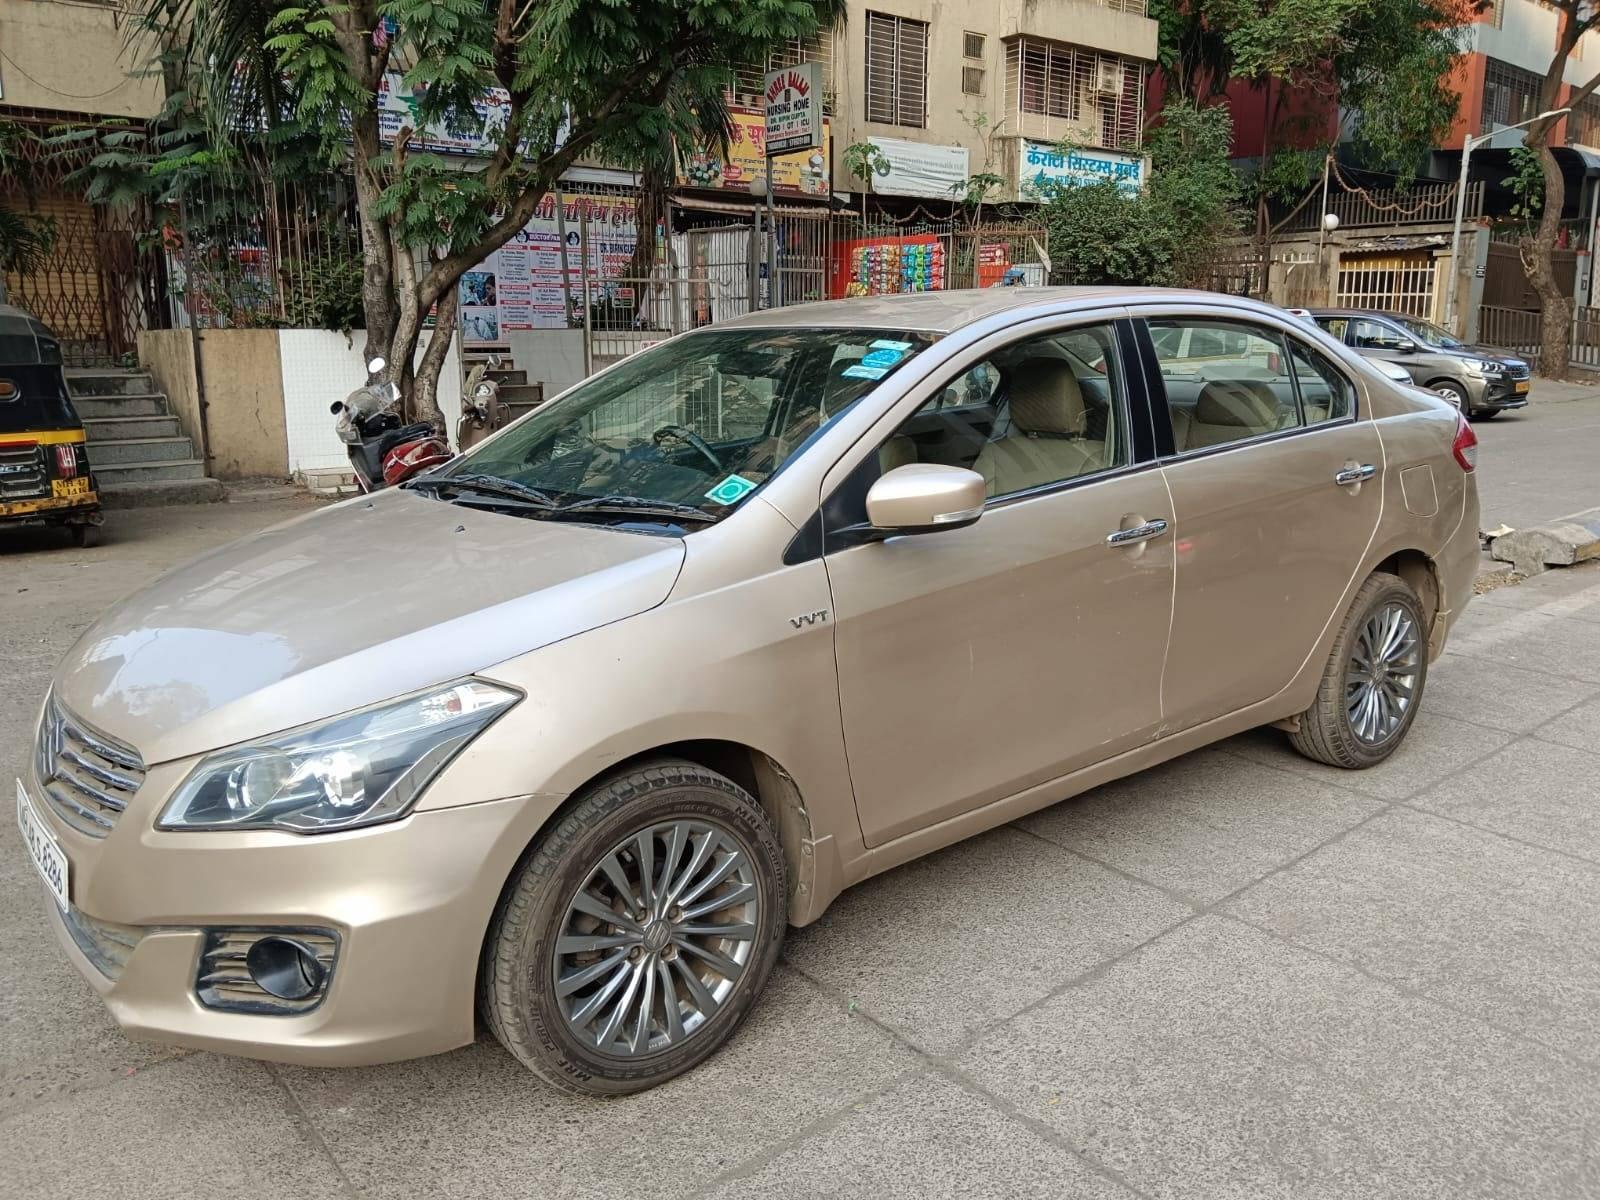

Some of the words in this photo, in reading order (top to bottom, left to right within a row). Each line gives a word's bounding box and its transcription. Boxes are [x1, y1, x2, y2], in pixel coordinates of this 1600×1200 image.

[767, 102, 791, 117] NURSING
[794, 98, 809, 111] HOME
[790, 610, 827, 629] VVT
[735, 806, 762, 832] MRF
[557, 1059, 593, 1083] MRF
